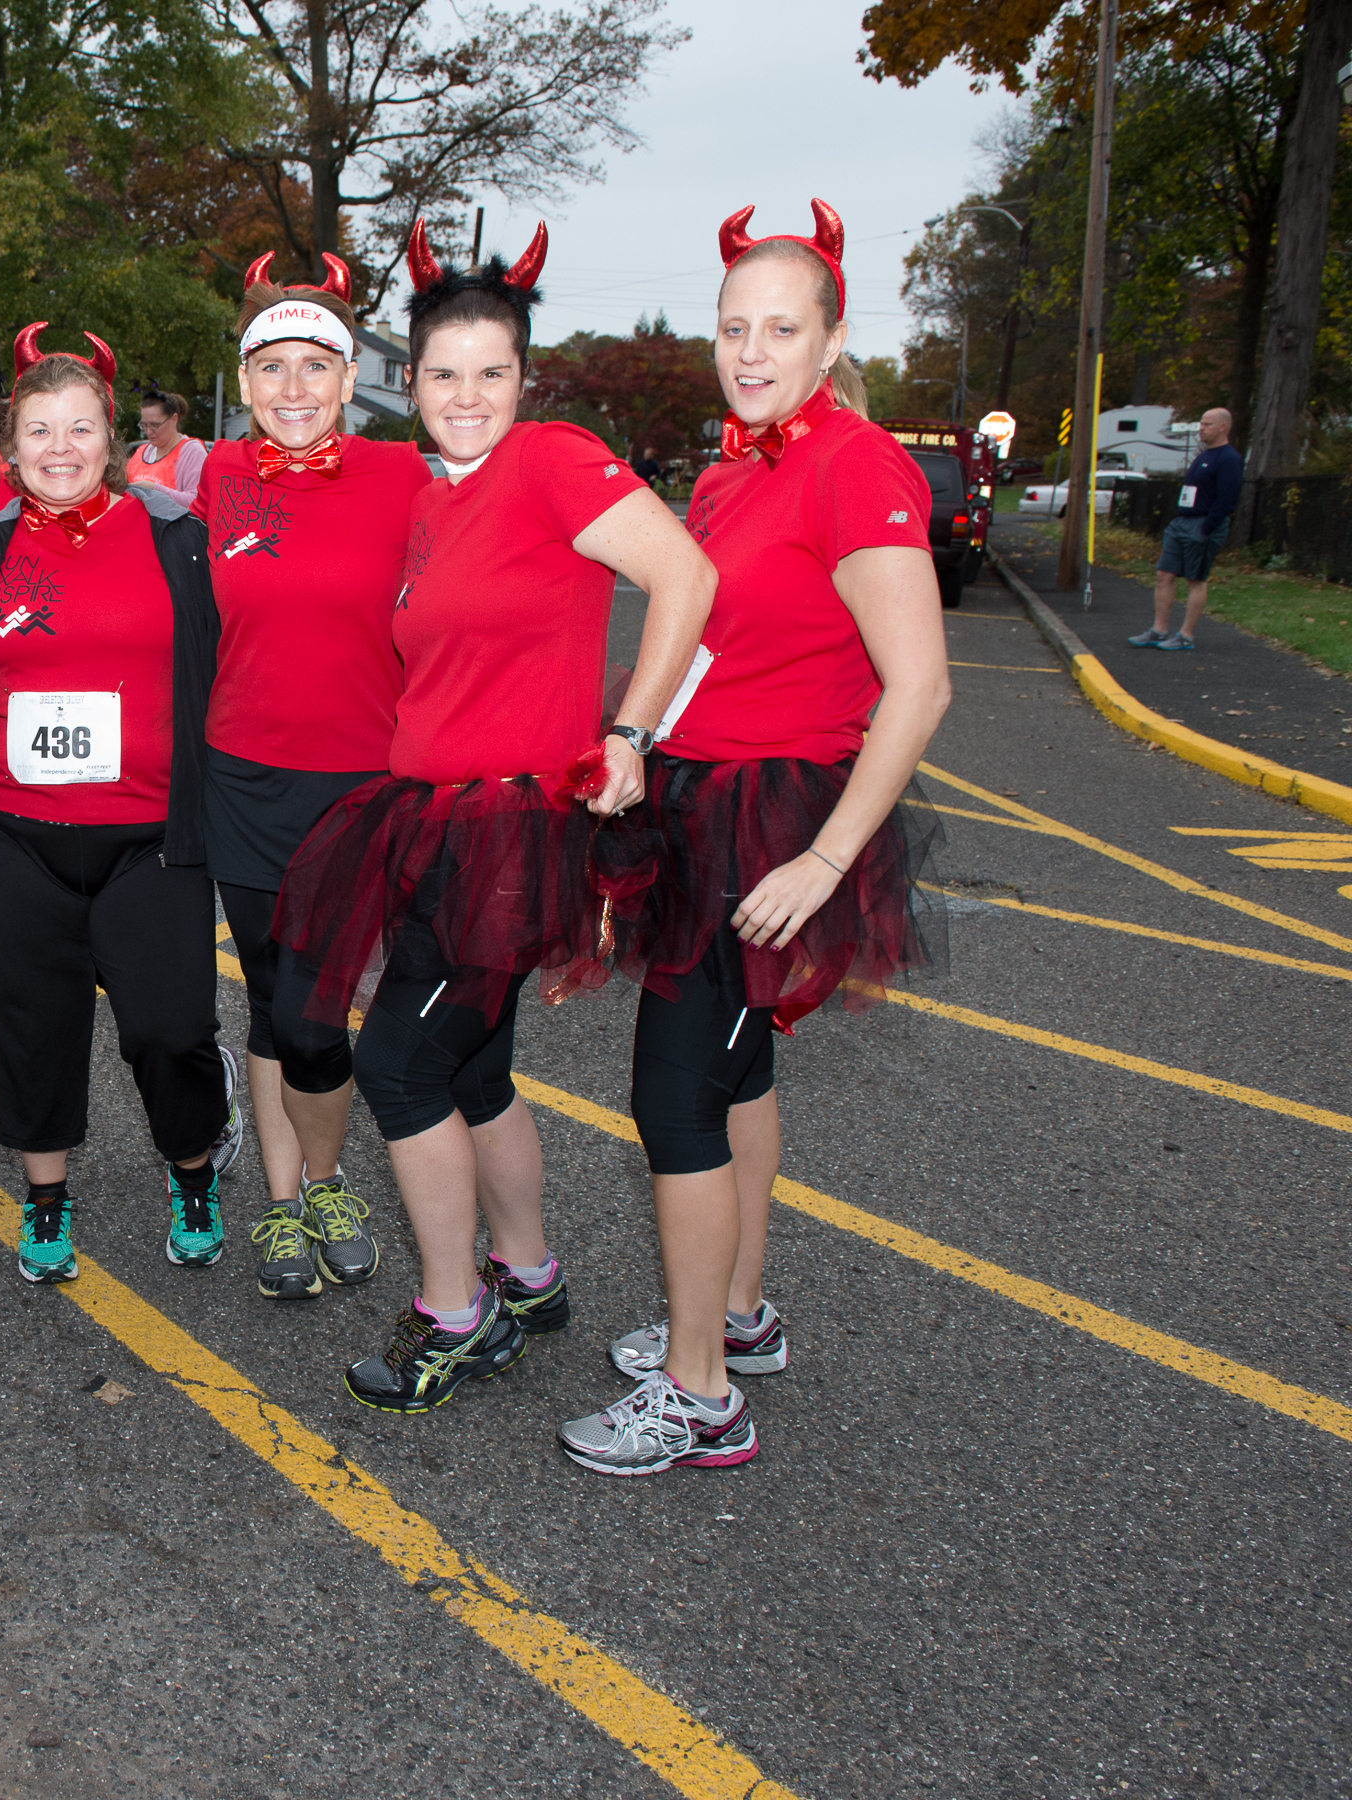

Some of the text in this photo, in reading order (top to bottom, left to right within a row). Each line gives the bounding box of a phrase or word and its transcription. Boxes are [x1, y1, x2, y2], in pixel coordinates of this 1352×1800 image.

[267, 308, 322, 323] TIMEX
[890, 432, 958, 446] PRISE FIRE CO.
[219, 475, 262, 494] RUN
[220, 491, 287, 513] WALK
[31, 726, 91, 759] 436
